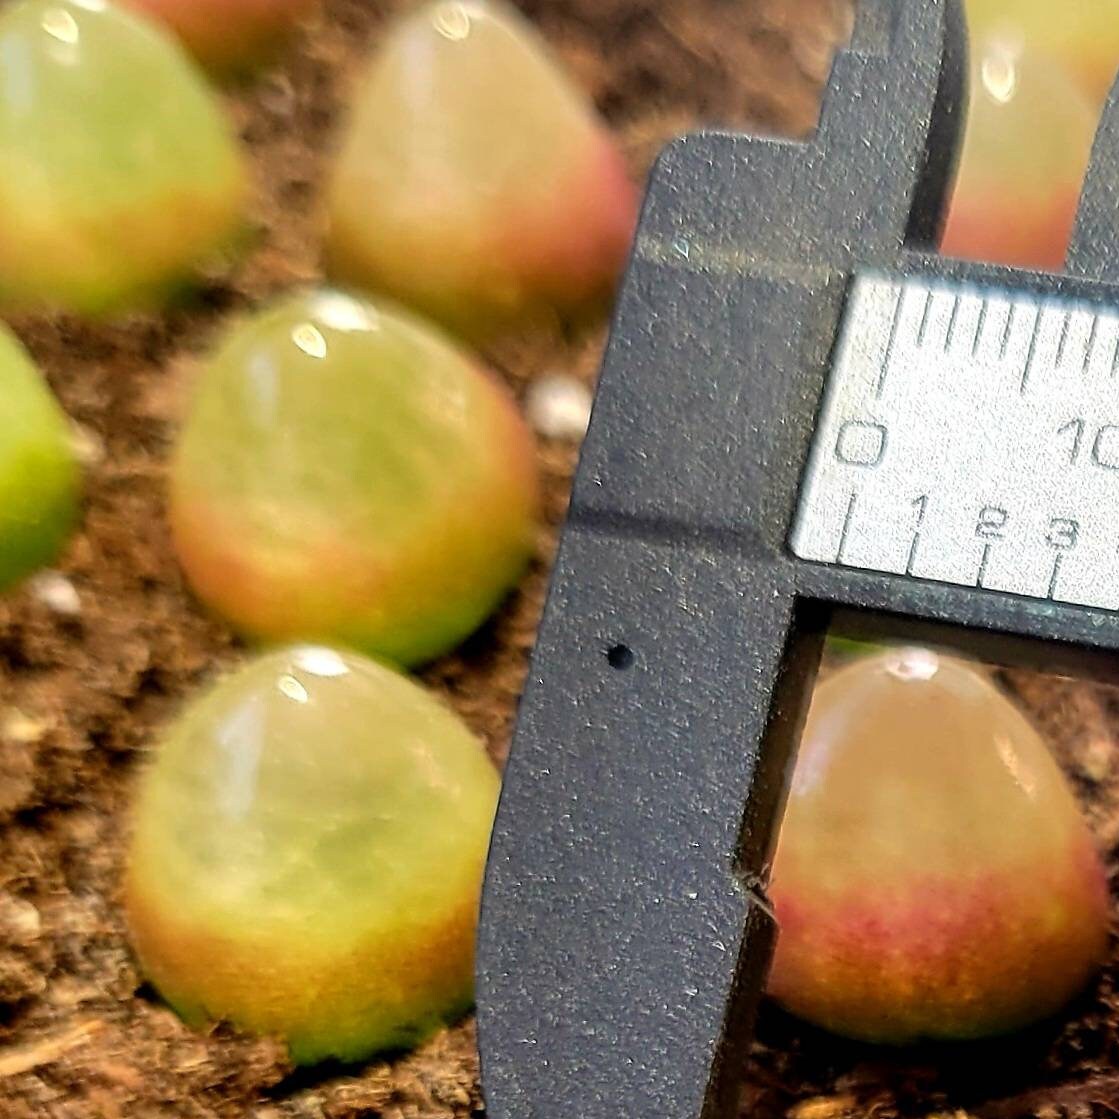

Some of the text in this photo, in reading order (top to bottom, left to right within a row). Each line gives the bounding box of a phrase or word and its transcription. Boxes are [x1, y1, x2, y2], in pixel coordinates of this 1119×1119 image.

[834, 419, 888, 466] 0
[911, 494, 929, 528] 1
[974, 505, 1008, 540] 2
[1044, 517, 1080, 551] 3
